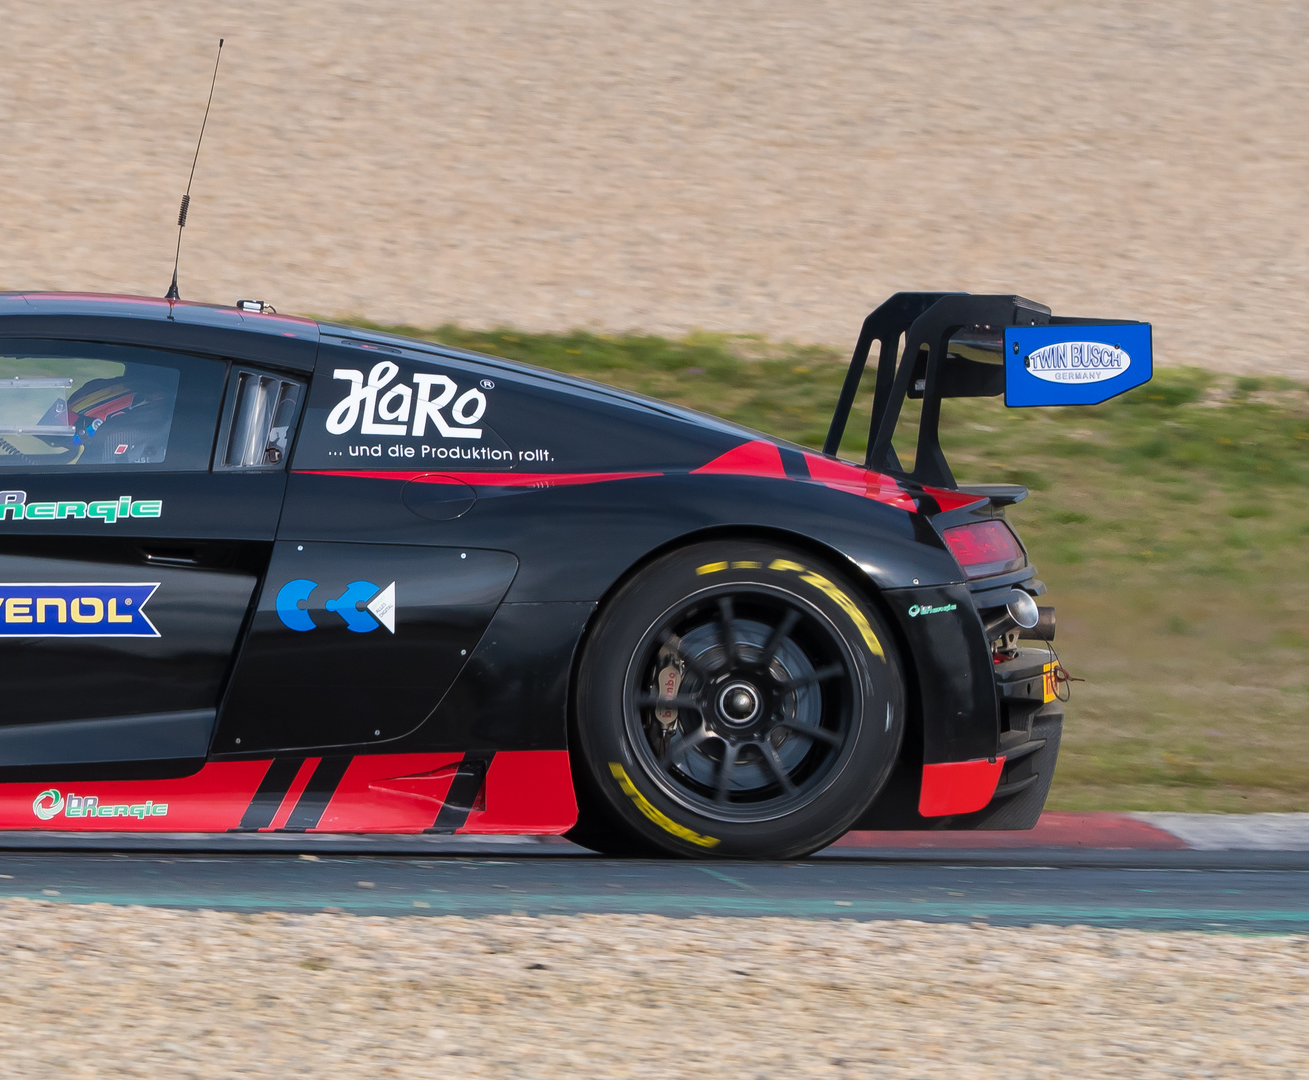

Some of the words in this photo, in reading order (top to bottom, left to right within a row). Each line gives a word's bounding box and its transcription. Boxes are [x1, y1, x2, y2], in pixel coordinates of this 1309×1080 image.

[1031, 344, 1068, 369] TWIN
[1071, 343, 1122, 368] BUSCH
[1055, 371, 1102, 381] GERMANY
[349, 444, 381, 457] und
[388, 443, 415, 458] die
[421, 445, 513, 461] Produktion
[519, 450, 555, 462] rollt.
